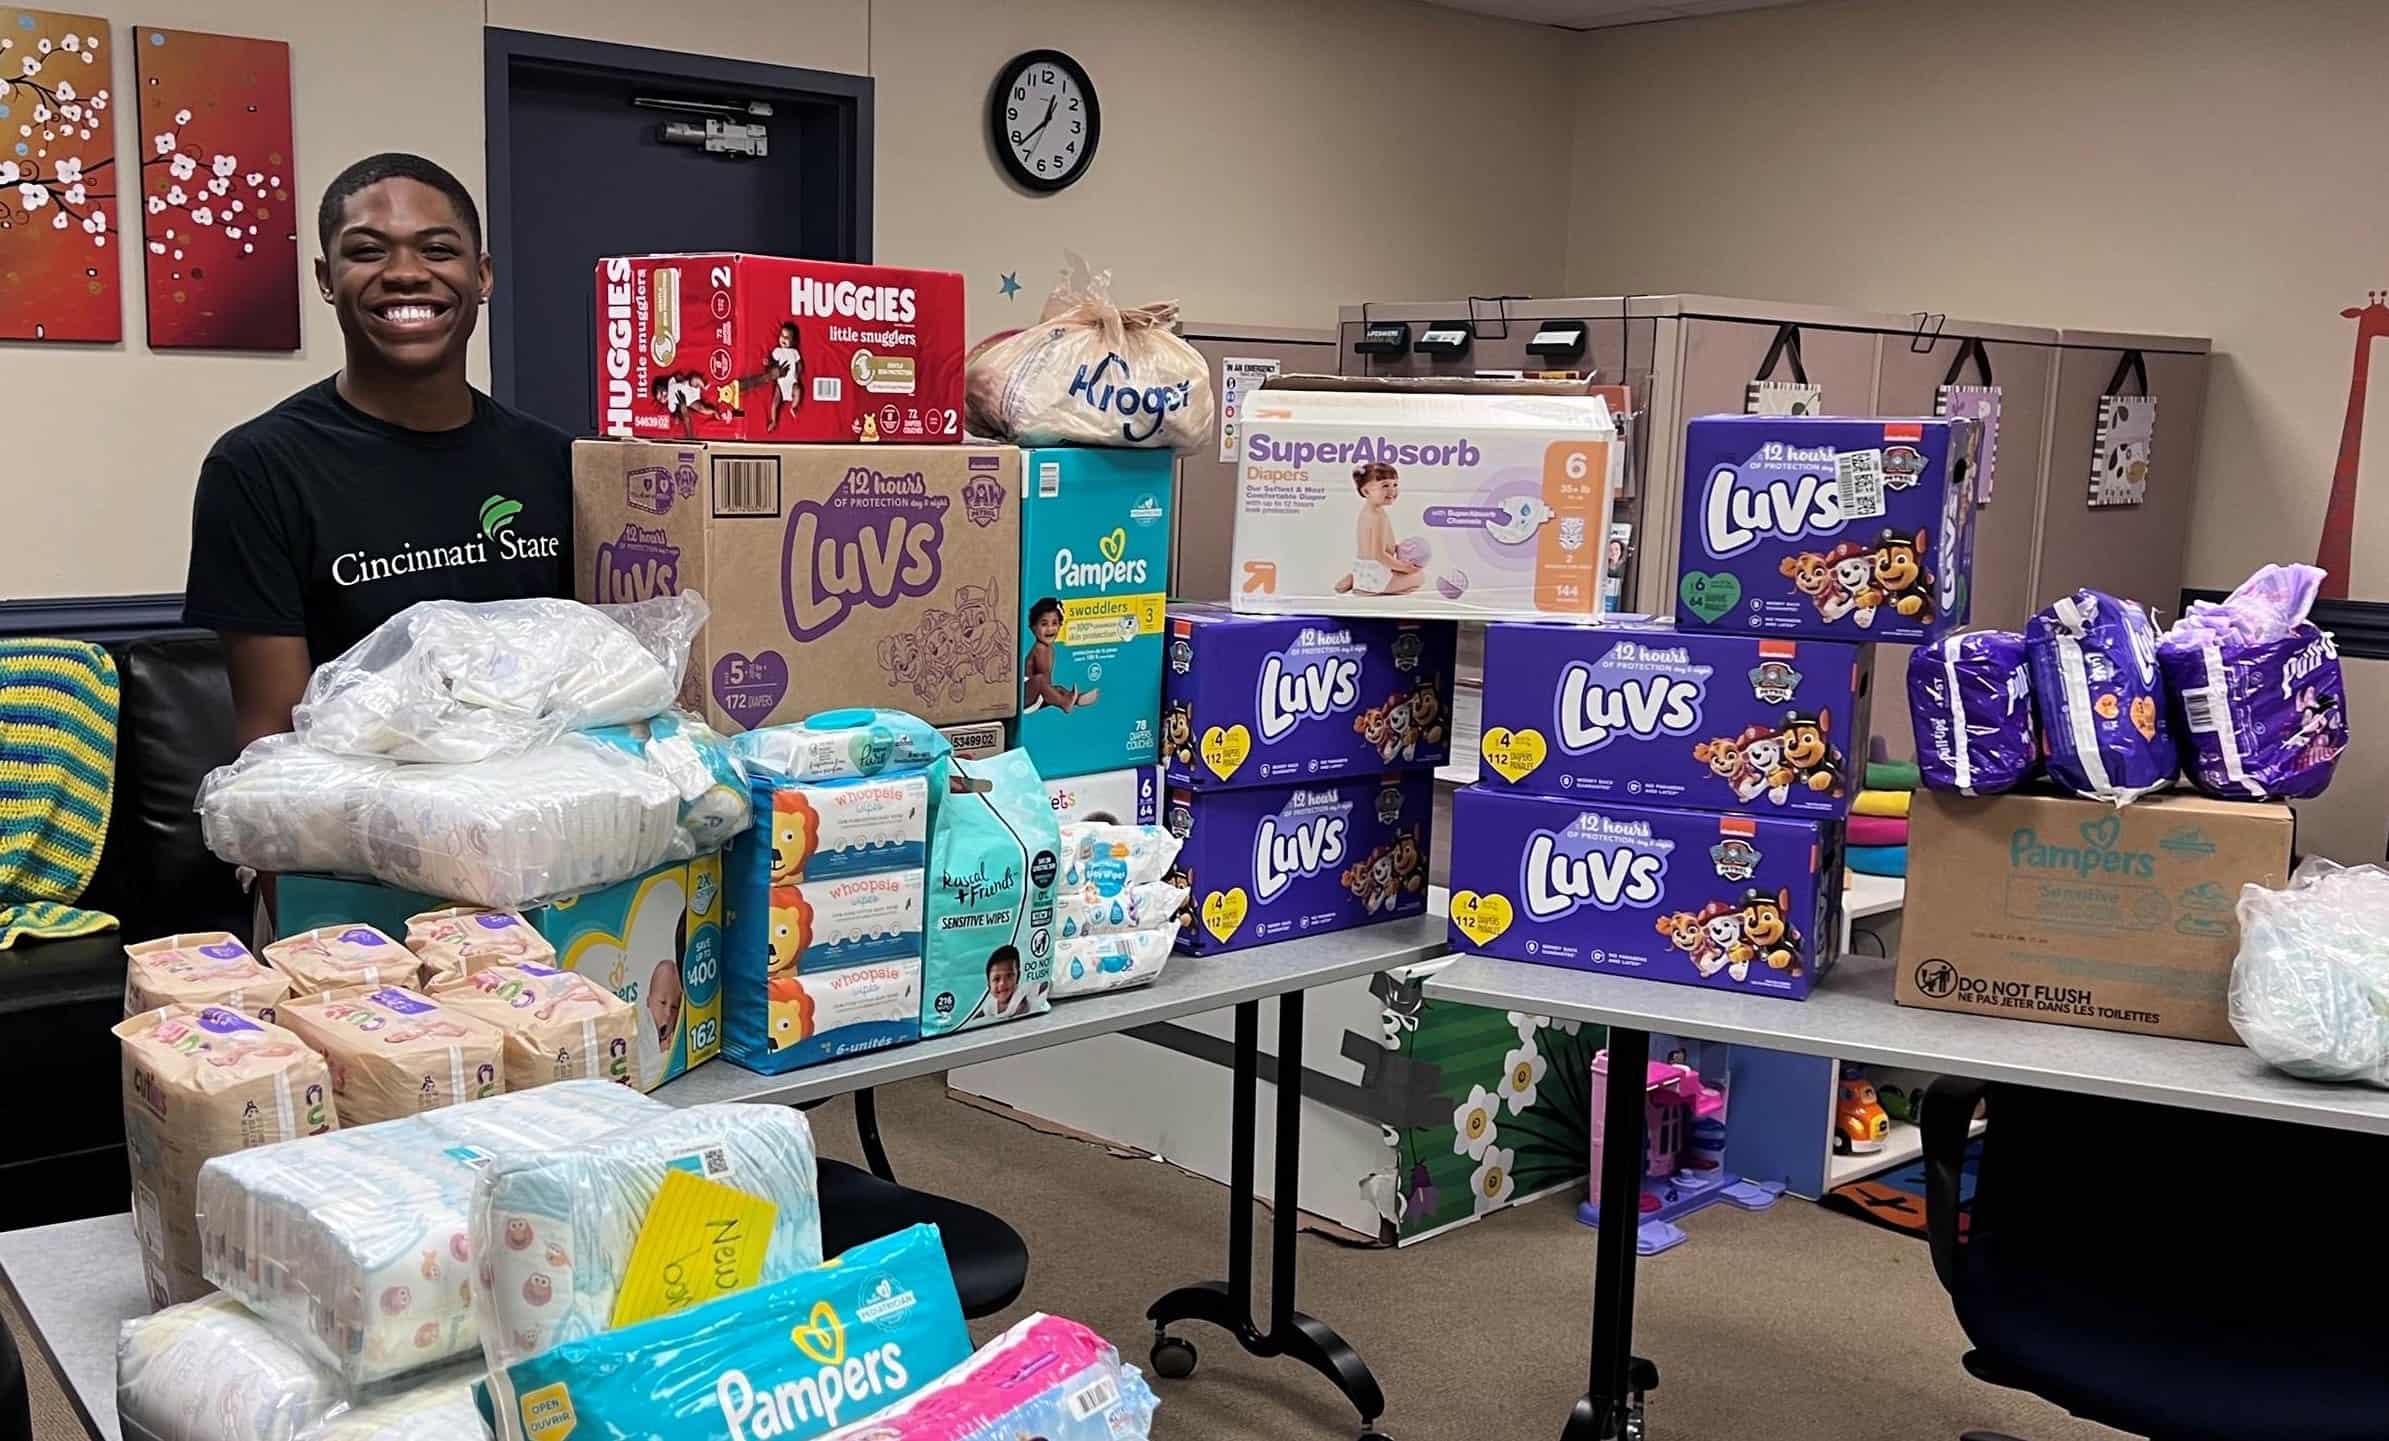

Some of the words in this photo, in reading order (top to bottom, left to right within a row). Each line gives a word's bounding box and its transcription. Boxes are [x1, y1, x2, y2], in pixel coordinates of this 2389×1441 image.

[1027, 72, 1036, 87] 11
[1042, 70, 1054, 84] 12
[1014, 87, 1025, 101] 10
[1062, 80, 1066, 94] 1
[1069, 98, 1078, 111] 2
[1008, 107, 1018, 120] 9
[1070, 121, 1081, 134] 3
[1011, 131, 1021, 143] 8
[1022, 149, 1031, 162] 7
[1066, 141, 1074, 153] 4
[1037, 160, 1046, 172] 6
[1053, 155, 1063, 168] 5
[711, 266, 731, 288] 2
[791, 276, 916, 323] HUGGIES
[635, 269, 648, 352] snugglers
[829, 326, 858, 342] little
[861, 330, 916, 347] snugglers
[607, 257, 633, 437] HUGGIES
[637, 356, 648, 398] little
[1069, 352, 1190, 442] Kroger
[908, 408, 918, 419] 72
[943, 409, 957, 434] 2
[1248, 433, 1481, 468] SuperAbsorb
[1762, 443, 1783, 461] 12
[1787, 446, 1834, 462] hours
[1566, 452, 1587, 480] 6
[1750, 462, 1761, 470] OF
[1764, 462, 1819, 471] PROTECTION
[848, 471, 870, 494] 12
[873, 472, 924, 495] hours
[1247, 466, 1309, 484] Diapers
[834, 498, 848, 508] OF
[850, 498, 909, 508] PROTECTION
[1708, 470, 1841, 552] Luvs
[626, 525, 638, 542] 12
[332, 533, 487, 586] Cincinnati
[500, 530, 559, 560] State
[790, 512, 935, 632] Luvs
[1055, 548, 1147, 592] Pampers
[1556, 585, 1579, 597] 144
[1695, 577, 1705, 591] 6
[1069, 601, 1128, 616] swaddlers
[1145, 608, 1153, 623] 3
[1301, 629, 1315, 646] 12
[1317, 629, 1351, 646] hours
[1614, 644, 1637, 661] 12
[1639, 646, 1690, 664] hours
[730, 661, 744, 684] 5
[1602, 661, 1614, 669] OF
[1616, 662, 1673, 673] PROTECTION
[725, 694, 746, 709] 172
[1260, 658, 1358, 738] Luvs
[1561, 668, 1698, 749] Luvs
[1135, 720, 1147, 730] 78
[1215, 732, 1223, 747] 4
[1499, 733, 1511, 748] 4
[1206, 754, 1221, 764] 112
[1487, 753, 1509, 765] 112
[834, 788, 904, 806] whoopsie
[1142, 779, 1152, 798] 6
[1292, 791, 1306, 806] 12
[1308, 790, 1339, 805] hours
[1140, 806, 1153, 816] 64
[1581, 814, 1600, 832] 12
[1603, 818, 1650, 837] hours
[1581, 832, 1634, 844] PROTECTION
[1256, 817, 1345, 898] Luvs
[2011, 827, 2155, 879] Pampers
[943, 862, 989, 889] Rascal
[1527, 836, 1660, 915] Luvs
[829, 878, 899, 899] whoopsie
[970, 866, 1014, 907] Friends
[1215, 896, 1223, 909] 4
[1467, 897, 1478, 910] 4
[942, 914, 984, 930] SENSITIVE
[986, 911, 1010, 926] WIPES
[1207, 917, 1221, 928] 112
[1456, 916, 1476, 927] 112
[1025, 961, 1037, 971] DO
[829, 966, 899, 991] whoopsie
[1027, 970, 1050, 980] FLUSH
[1958, 977, 1987, 994] DO
[1992, 980, 2031, 998] NOT
[2035, 985, 2092, 1005] FLUSH
[1958, 992, 1972, 1002] NE
[1976, 993, 1998, 1005] PAS
[2000, 997, 2033, 1010] JETER
[2037, 1000, 2071, 1014] DANS
[2073, 1004, 2095, 1017] LES
[2098, 1007, 2160, 1024] TOILETTES
[689, 1018, 717, 1052] 162
[706, 1218, 742, 1290] New
[717, 1342, 908, 1441] Pampers
[532, 1400, 559, 1414] OPEN
[531, 1412, 570, 1432] OUVRIR
